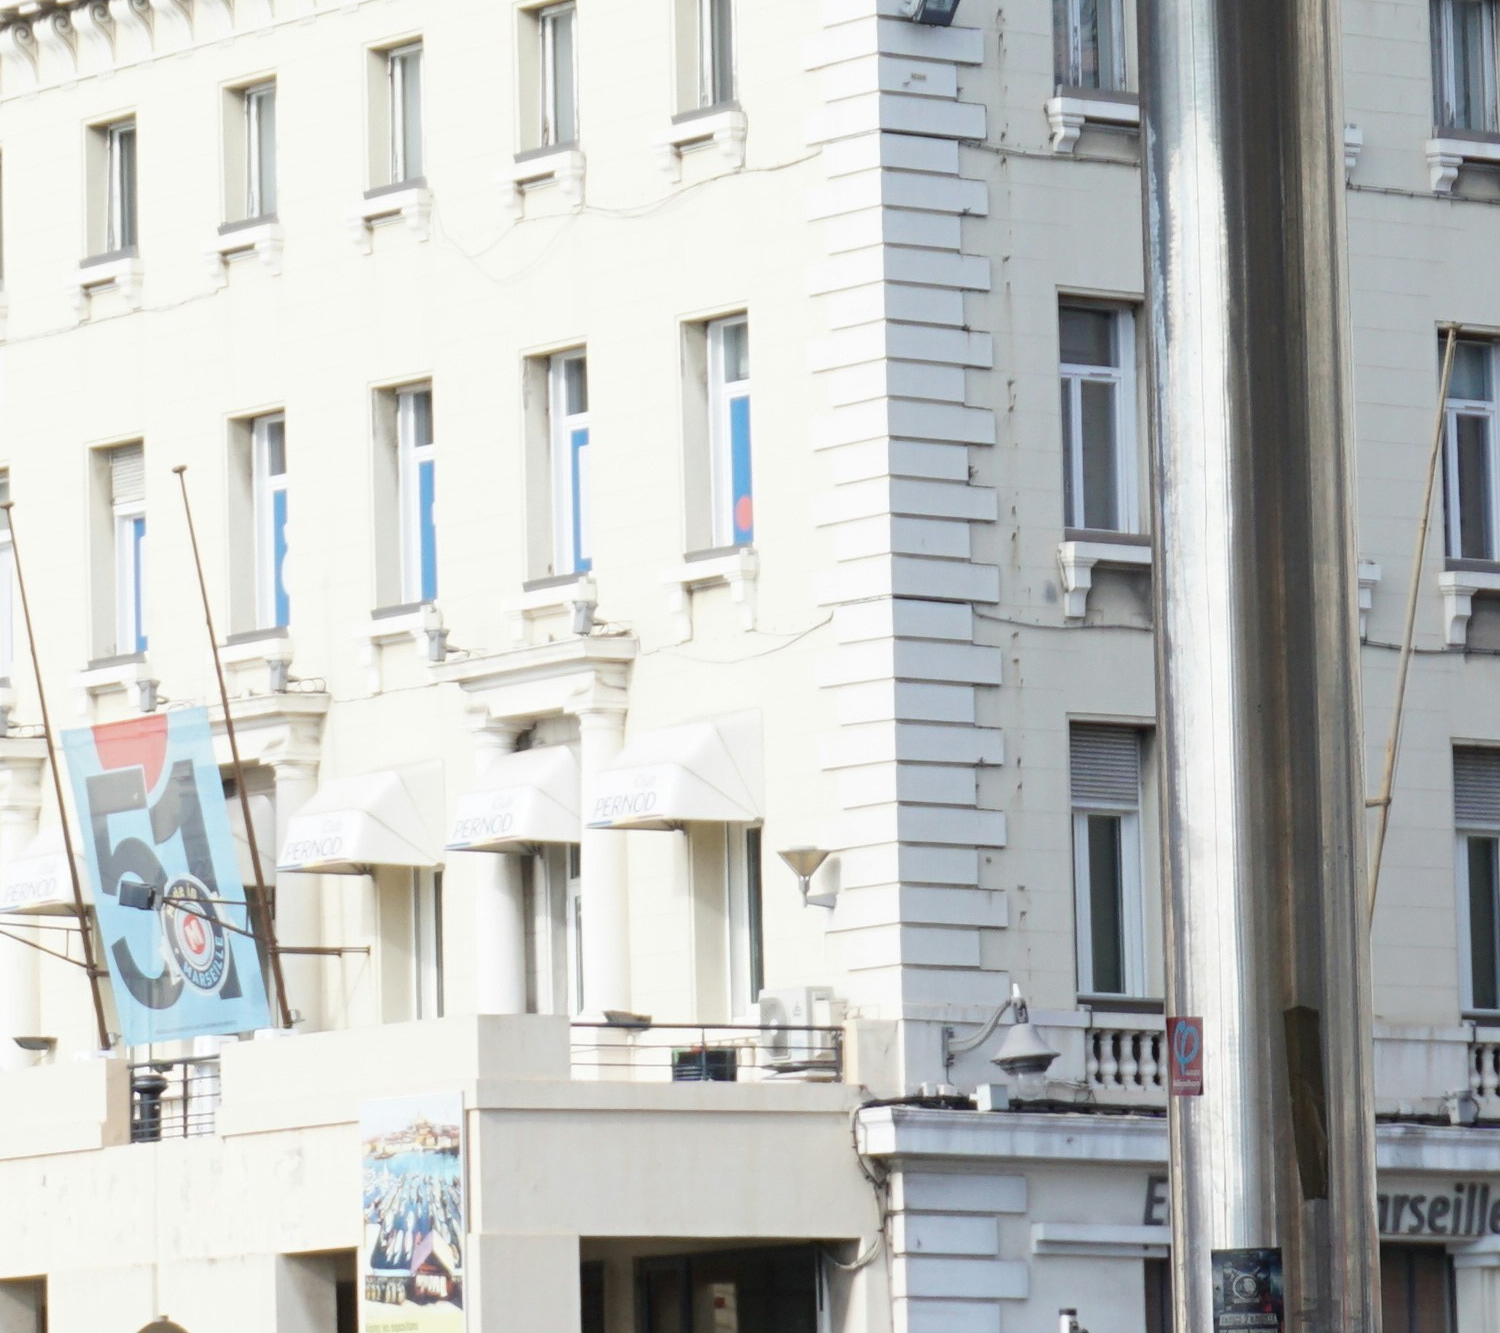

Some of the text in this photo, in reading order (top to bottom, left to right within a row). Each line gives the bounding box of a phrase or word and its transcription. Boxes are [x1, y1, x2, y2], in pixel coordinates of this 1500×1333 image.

[593, 790, 657, 818] PERNOD
[452, 813, 513, 839] PERNOD
[283, 836, 343, 861] PERNOD
[4, 878, 58, 903] PERNOD
[85, 758, 244, 1011] 51
[182, 936, 225, 987] MARSEILLE
